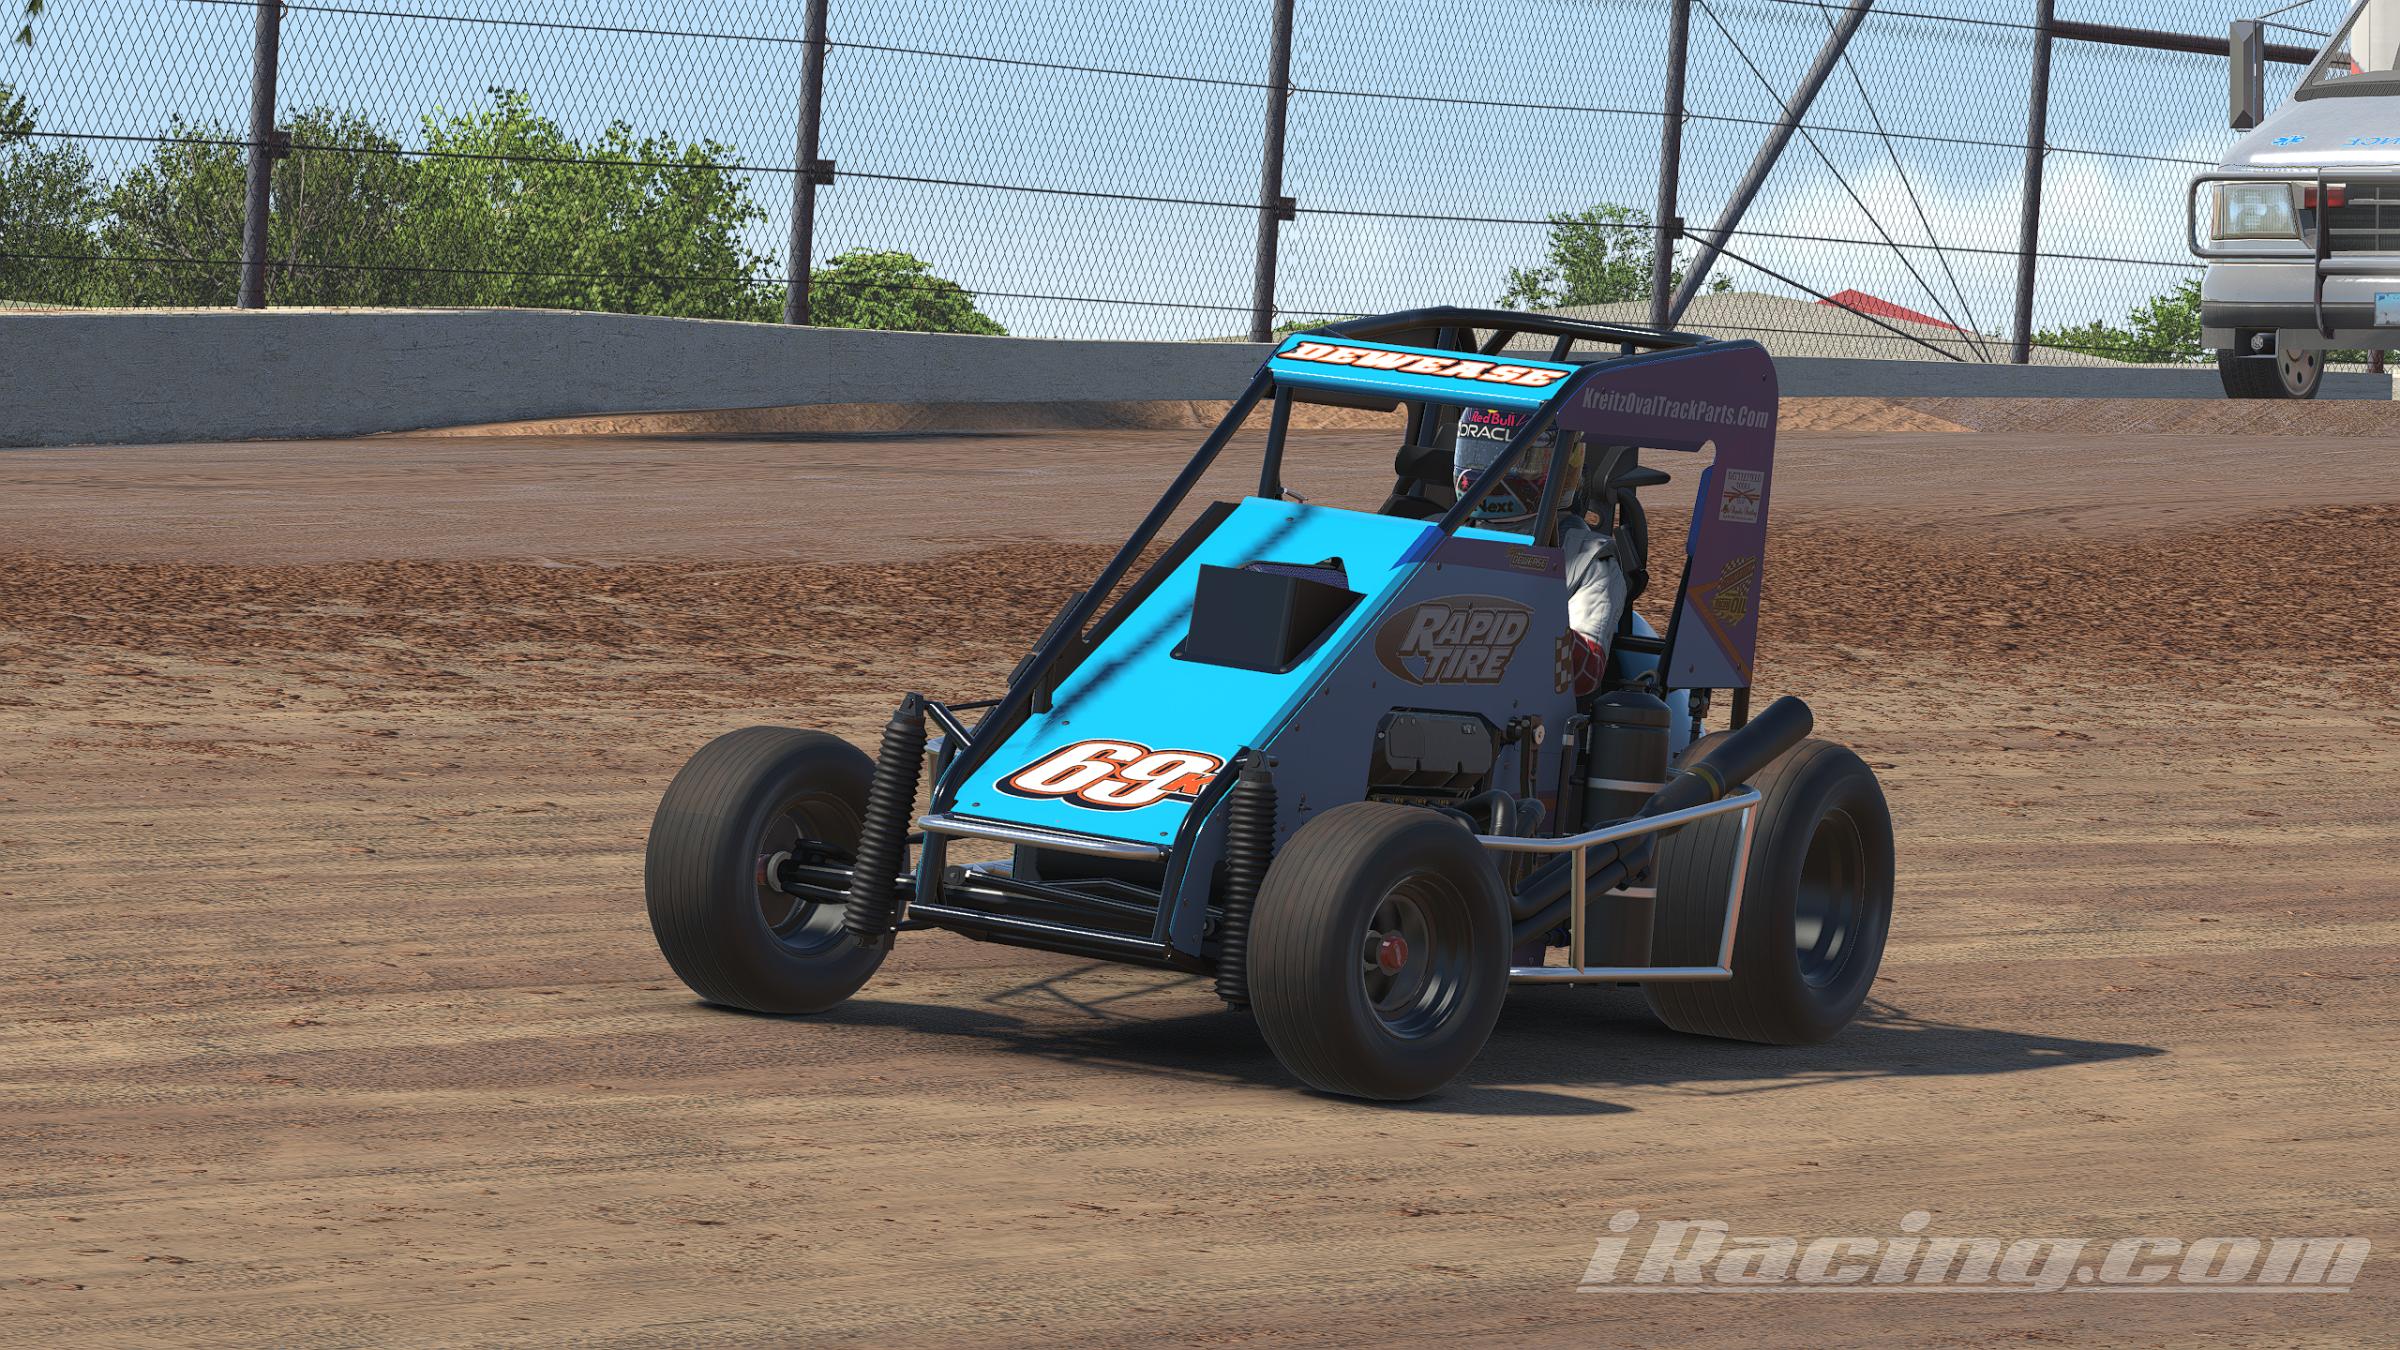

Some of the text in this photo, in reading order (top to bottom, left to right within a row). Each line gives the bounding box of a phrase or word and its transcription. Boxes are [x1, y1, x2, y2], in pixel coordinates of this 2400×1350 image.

[1278, 342, 1571, 387] DEWEASE
[1470, 410, 1515, 426] Red Bull
[1582, 387, 1769, 429] KreitzOvalTrackParts.Com
[1458, 421, 1514, 442] ORACL
[1399, 603, 1531, 653] RAPID
[1422, 645, 1512, 682] TIRE
